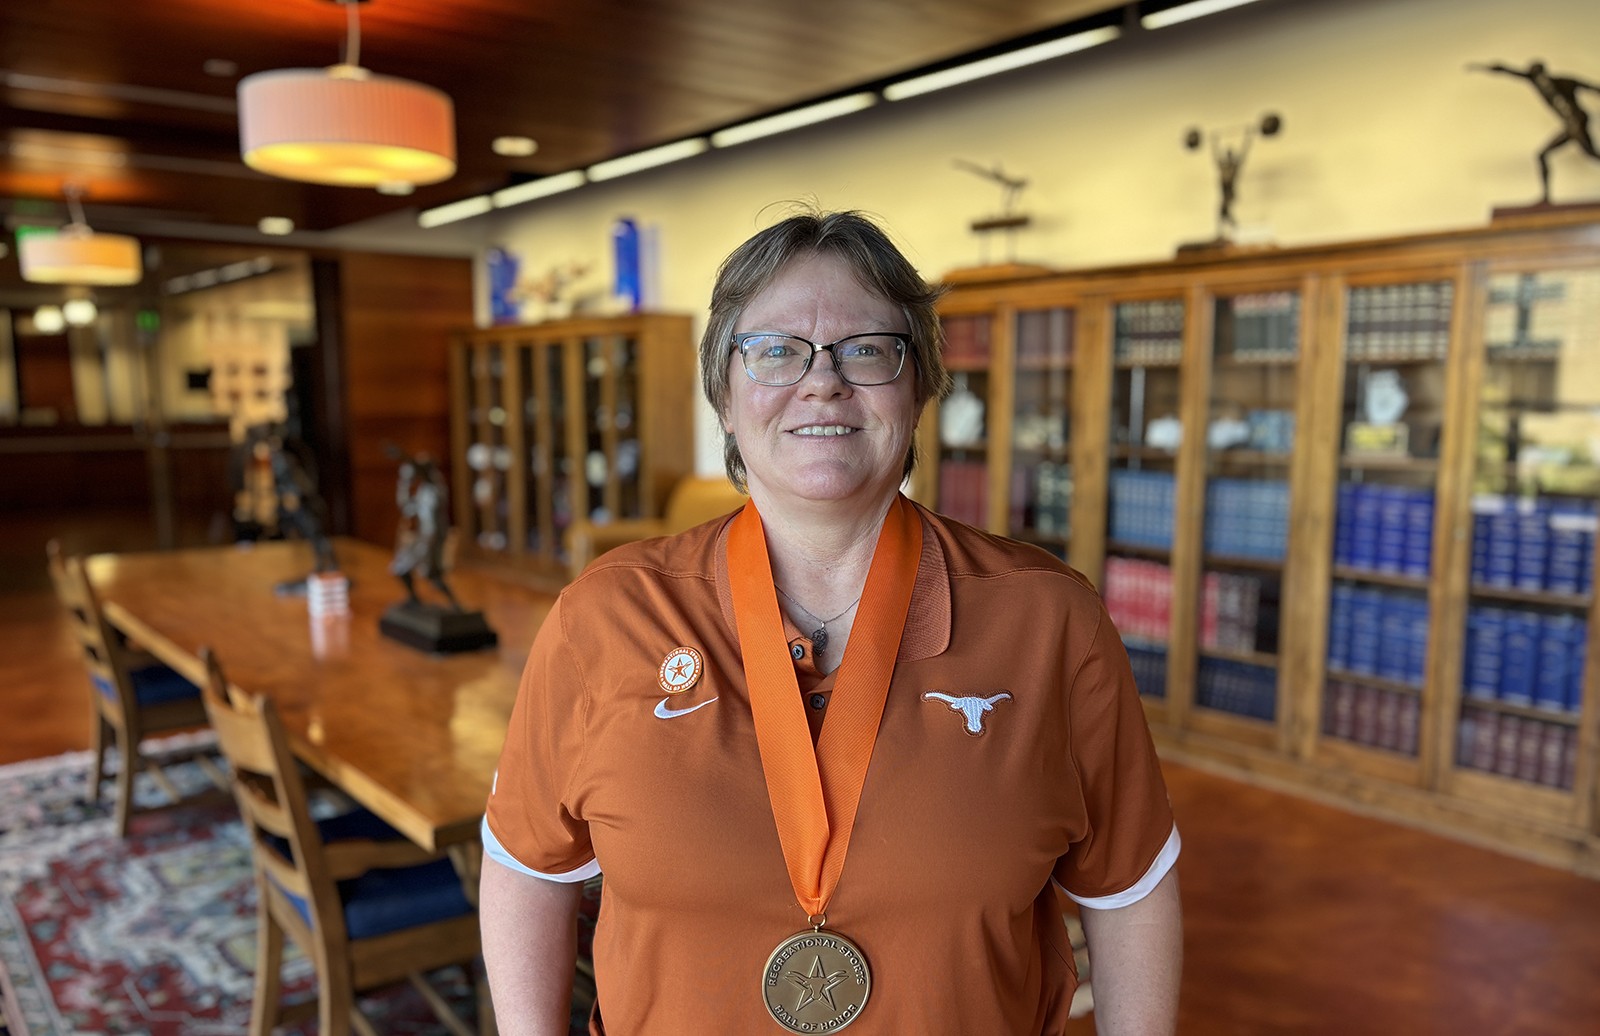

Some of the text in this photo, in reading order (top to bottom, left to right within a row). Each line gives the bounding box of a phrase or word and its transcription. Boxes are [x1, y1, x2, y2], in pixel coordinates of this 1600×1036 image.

[768, 938, 865, 987] RECREATIONAL SPORTS
[773, 1004, 858, 1031] HALL OF HONOR
